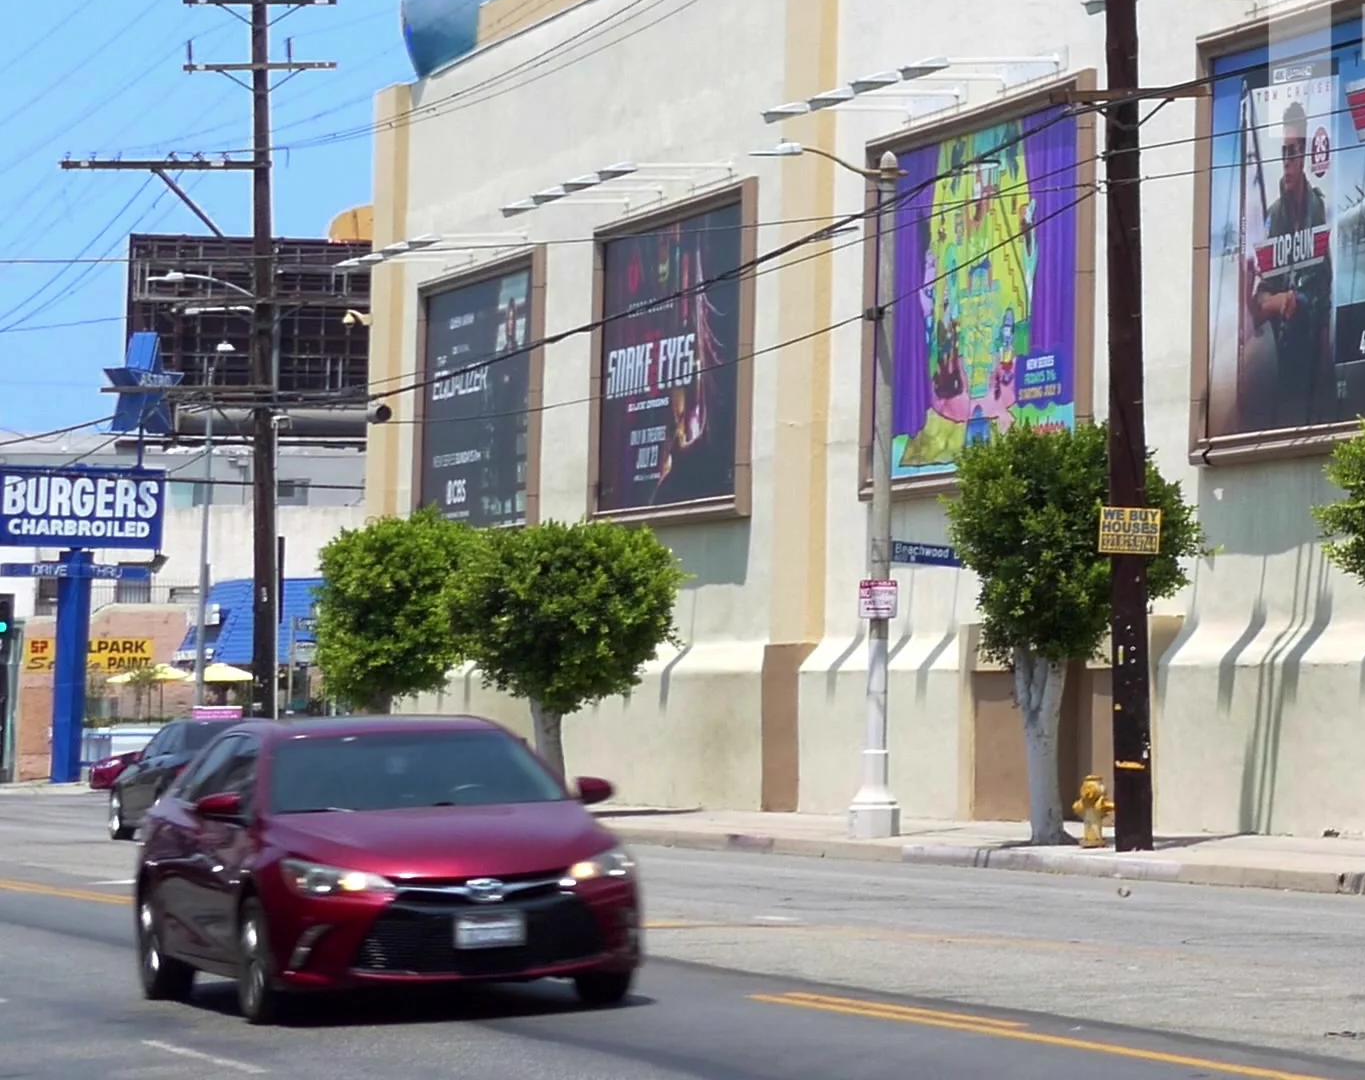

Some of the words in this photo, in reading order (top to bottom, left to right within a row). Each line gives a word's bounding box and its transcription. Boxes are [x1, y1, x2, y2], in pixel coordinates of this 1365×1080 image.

[1256, 90, 1278, 104] TOM
[1286, 81, 1332, 99] CRUISE
[1272, 233, 1293, 268] TOP
[1292, 229, 1314, 262] GUN
[606, 342, 654, 399] SNAKE
[658, 332, 696, 390] EYES
[3, 475, 159, 518] BURGERS
[1103, 509, 1125, 521] WE
[1129, 509, 1159, 522] BUY
[8, 519, 150, 538] CHARBROILED
[1102, 521, 1158, 534] HOUSES
[894, 543, 950, 559] Beachwood
[31, 564, 69, 577] DRIVE
[89, 564, 123, 579] THRU
[107, 656, 152, 670] PAINT
